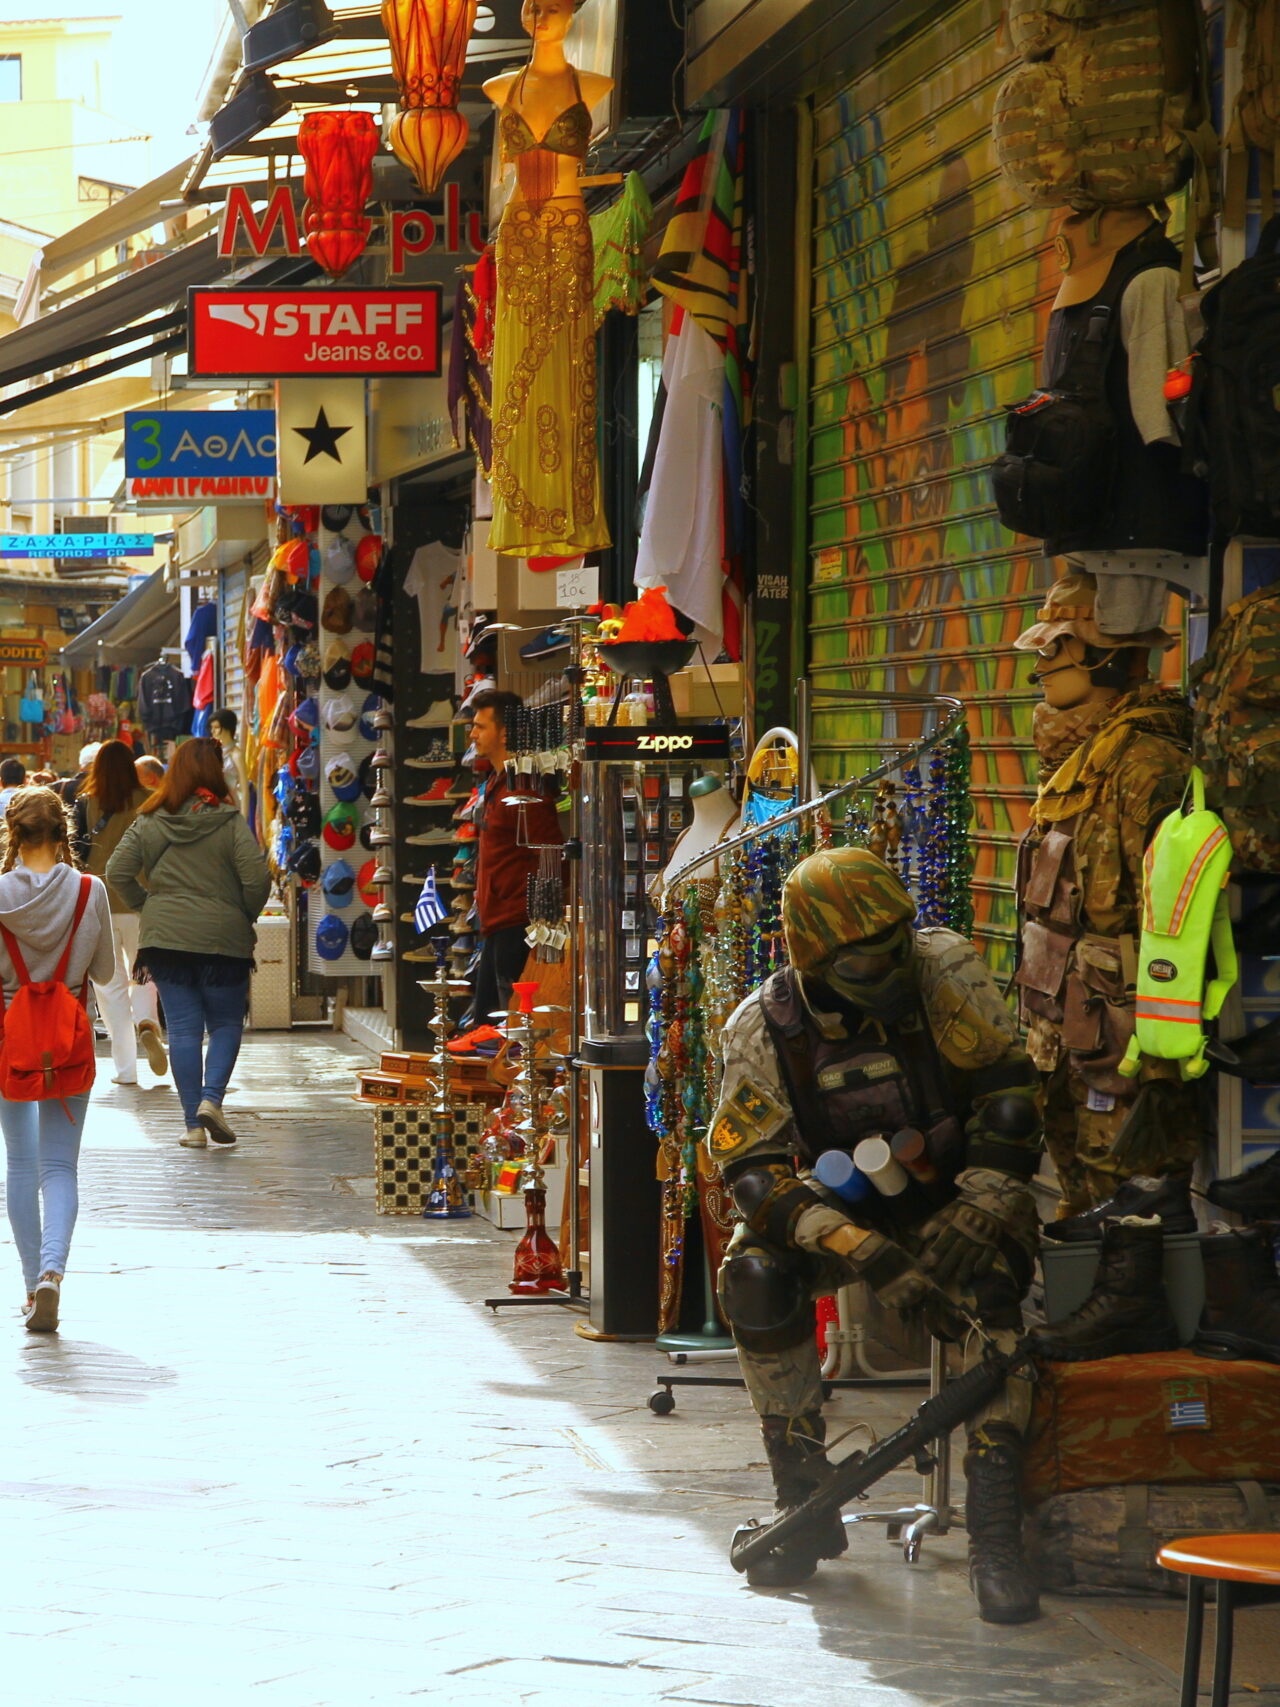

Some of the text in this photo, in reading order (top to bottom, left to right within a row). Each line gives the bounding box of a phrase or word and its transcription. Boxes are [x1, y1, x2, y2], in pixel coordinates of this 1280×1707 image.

[391, 182, 488, 276] plu
[273, 303, 423, 337] STAFF
[131, 418, 163, 470] 3
[28, 550, 93, 559] RECORDS
[107, 549, 126, 557] CD
